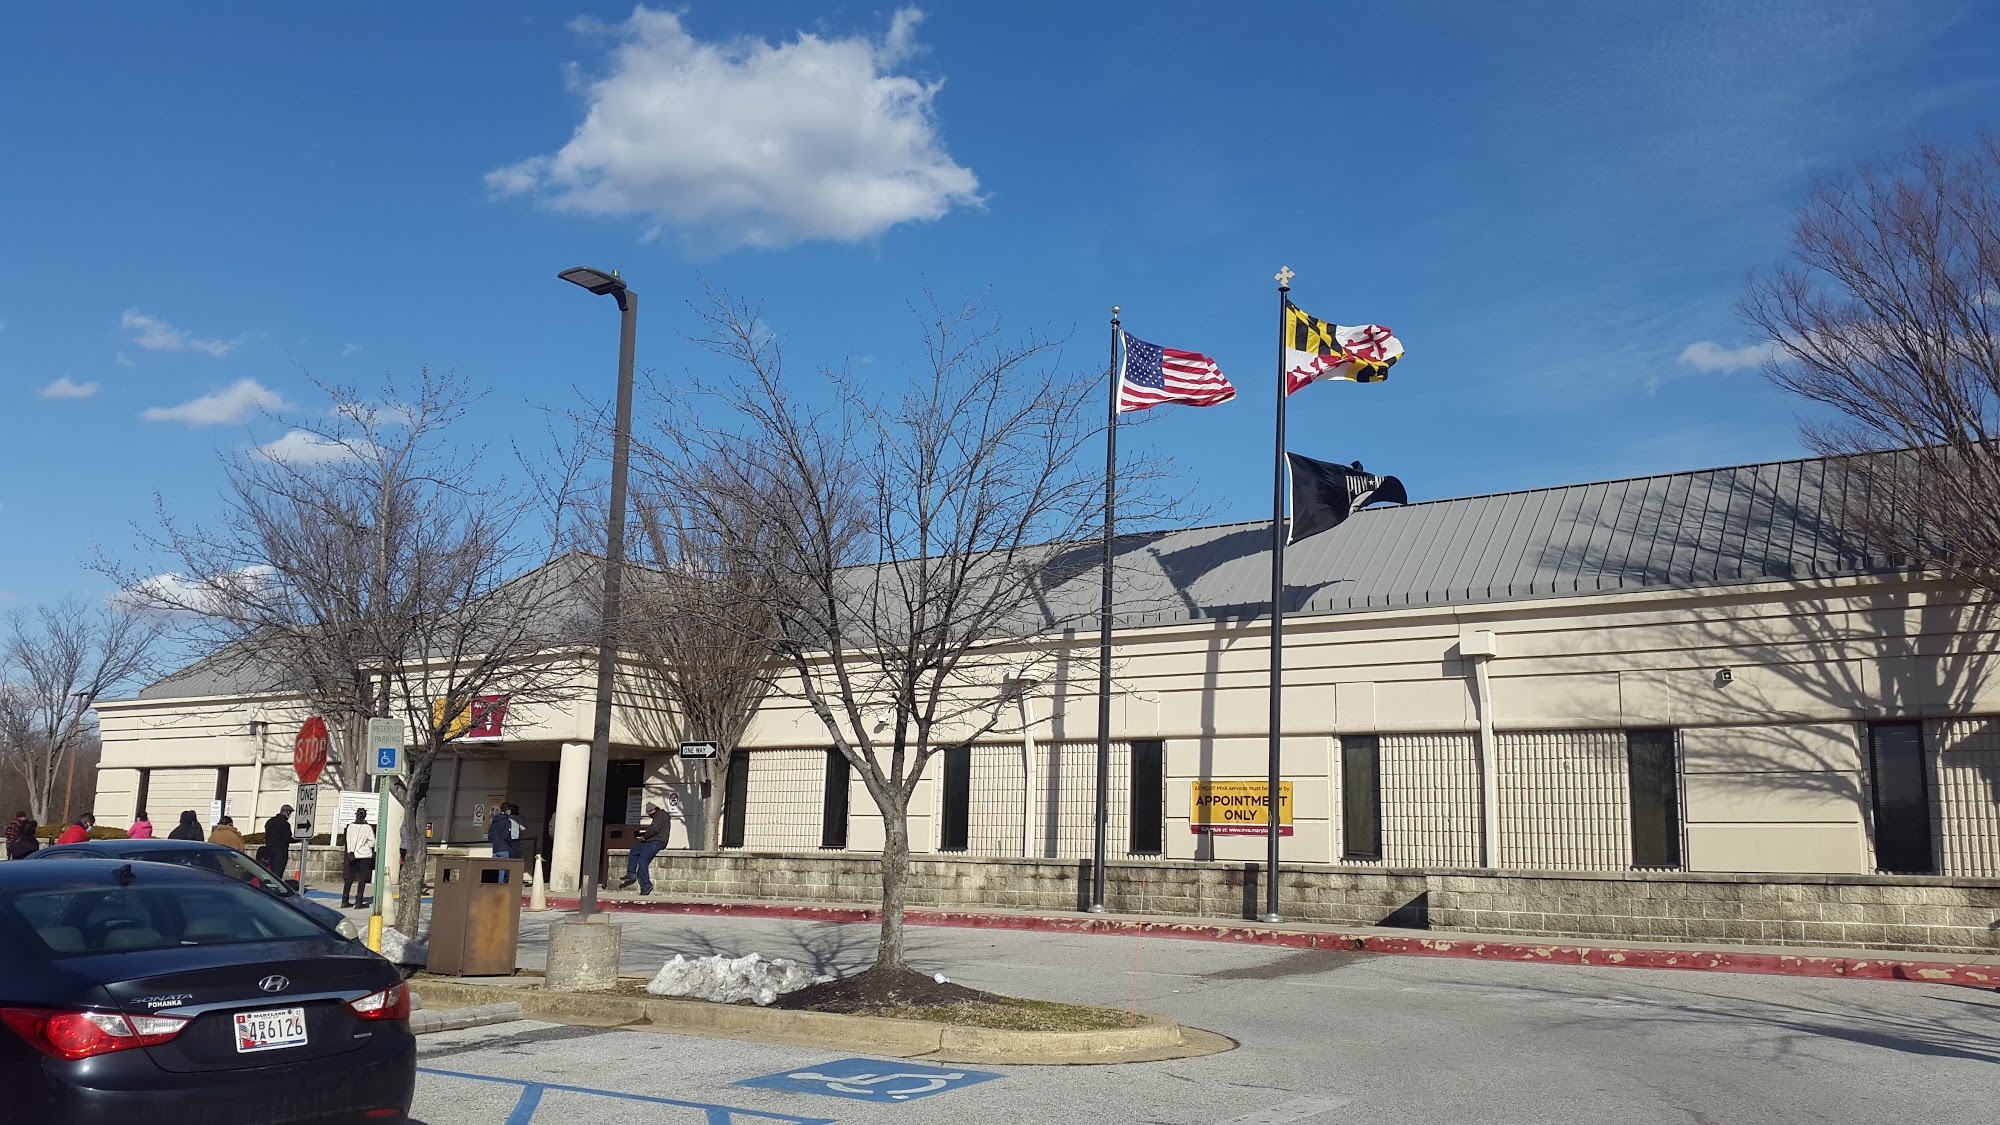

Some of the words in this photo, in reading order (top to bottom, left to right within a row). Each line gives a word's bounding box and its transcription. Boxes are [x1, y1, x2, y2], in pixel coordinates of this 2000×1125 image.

[373, 725, 402, 733] RESERVED
[374, 735, 401, 743] PARKING
[296, 738, 327, 763] STOP
[300, 788, 315, 801] ONE
[1196, 795, 1287, 807] APPOINTMET
[298, 803, 314, 816] WAY
[1224, 810, 1257, 821] ONLY
[129, 993, 193, 1004] SONATA
[147, 1000, 182, 1009] POHANKA
